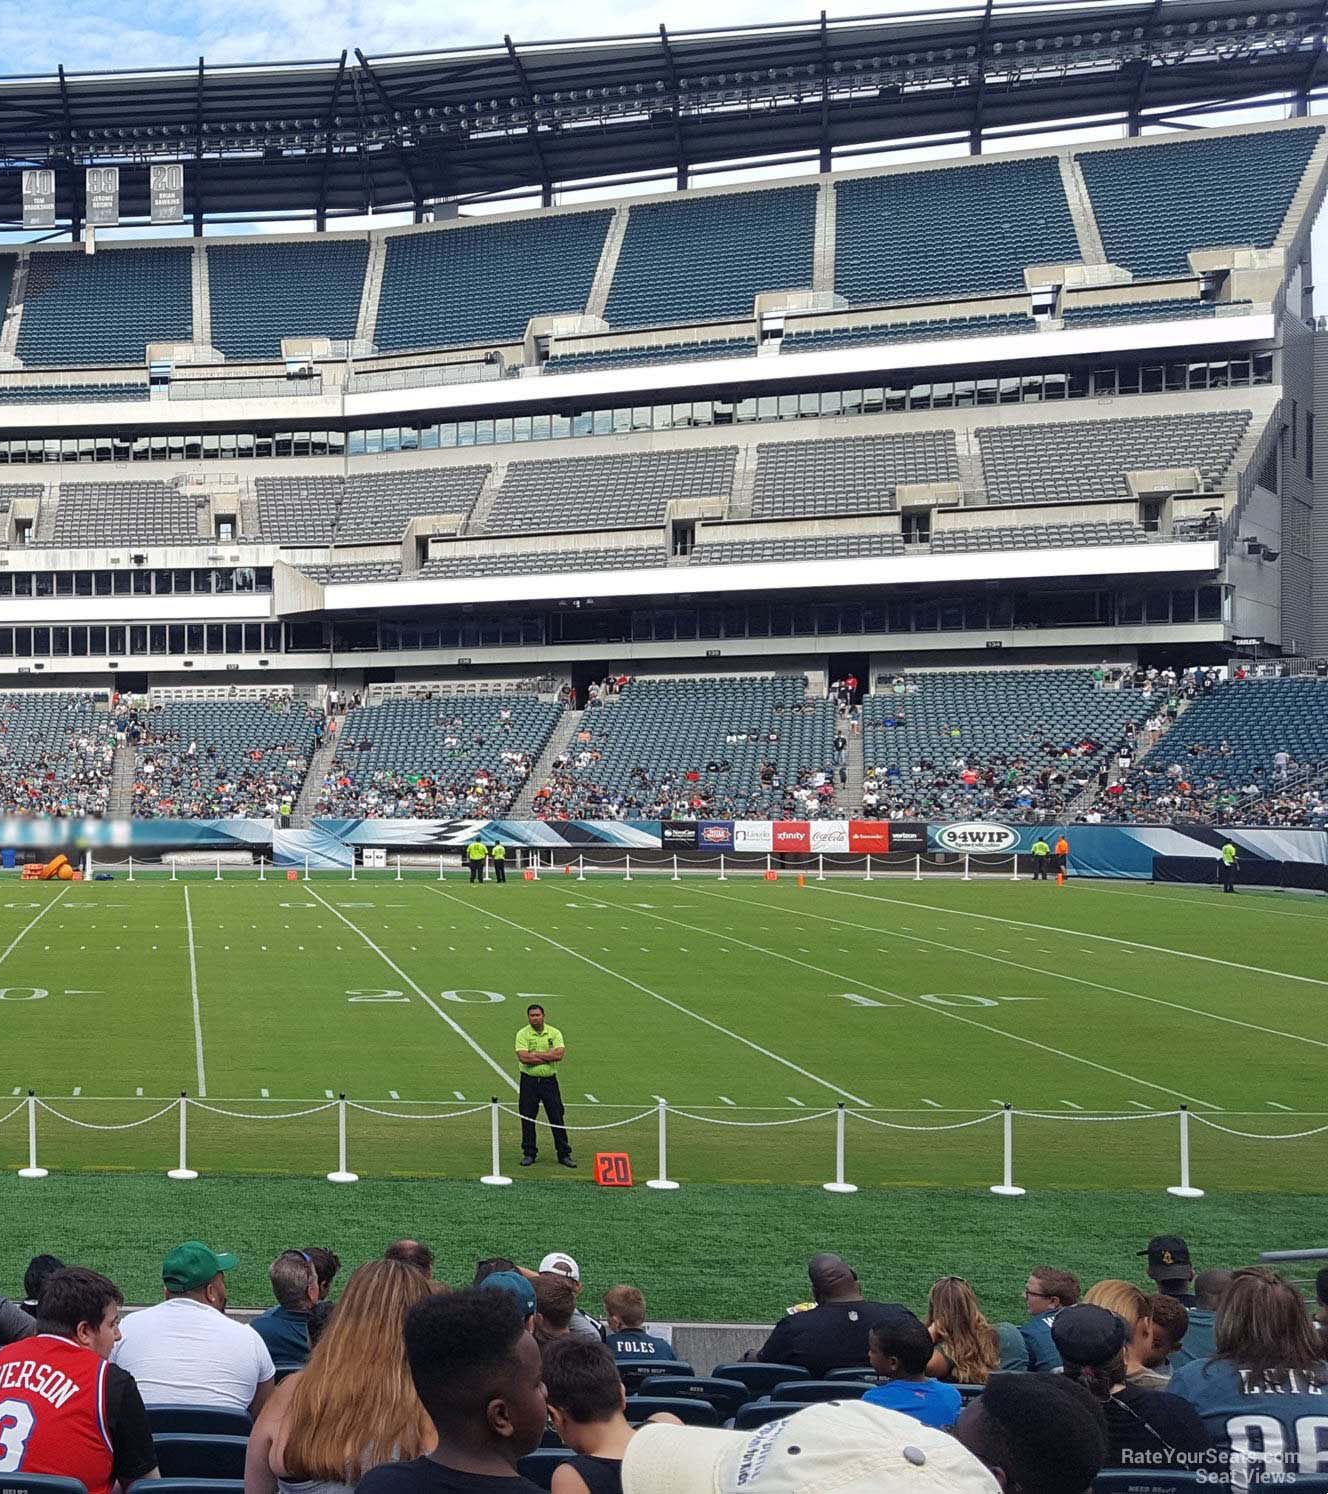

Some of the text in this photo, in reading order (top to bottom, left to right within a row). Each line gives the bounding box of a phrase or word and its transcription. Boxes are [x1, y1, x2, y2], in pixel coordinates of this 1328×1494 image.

[25, 171, 52, 196] 40
[88, 169, 117, 193] 99
[153, 166, 181, 191] 20
[777, 832, 806, 841] xfinity
[947, 831, 1010, 843] 94WIP
[599, 1157, 630, 1183] 20
[616, 1341, 656, 1354] FOLES
